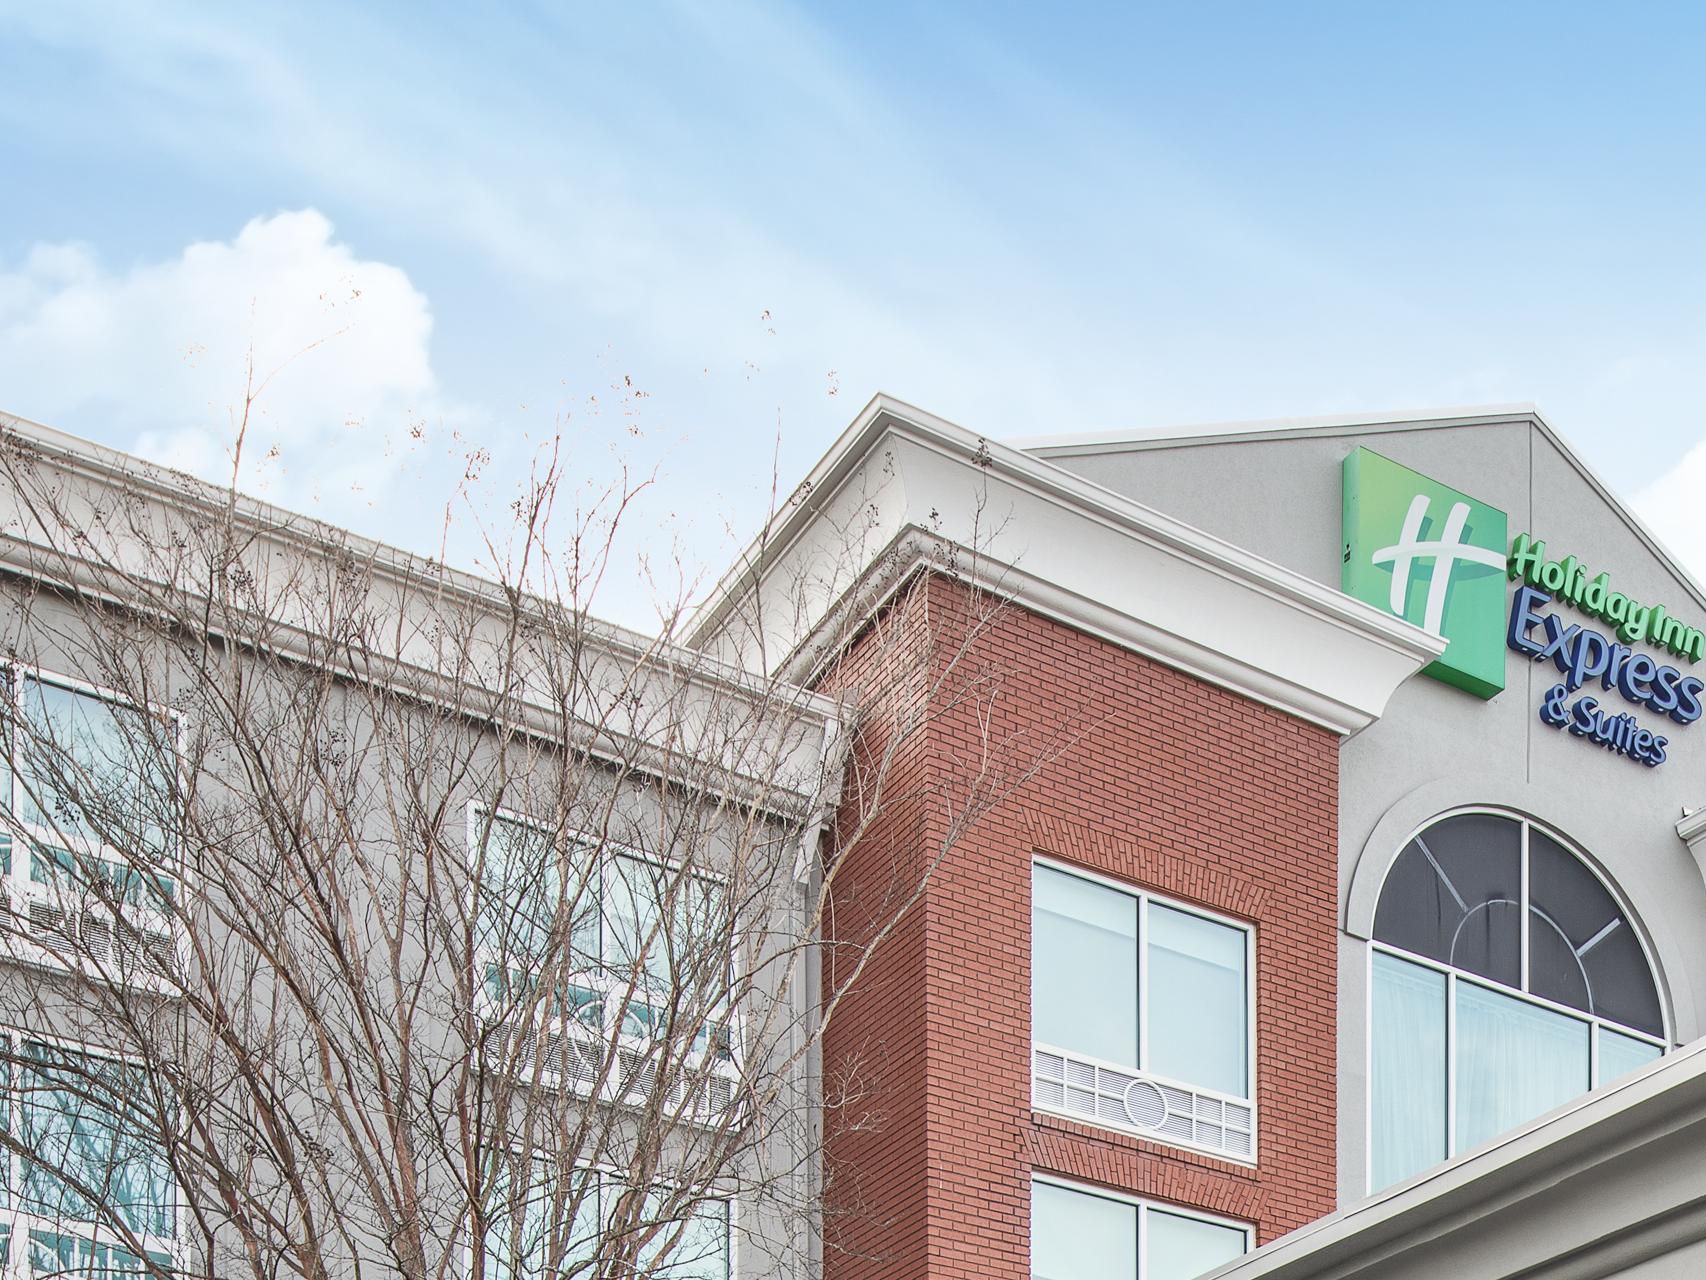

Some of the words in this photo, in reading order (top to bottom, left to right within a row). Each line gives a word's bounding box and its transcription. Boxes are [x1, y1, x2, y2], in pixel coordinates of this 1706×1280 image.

[1507, 585, 1705, 726] Express
[1508, 532, 1650, 645] Holiday
[1646, 603, 1706, 665] Inn
[1540, 683, 1571, 728] &
[1571, 696, 1669, 769] Suites
